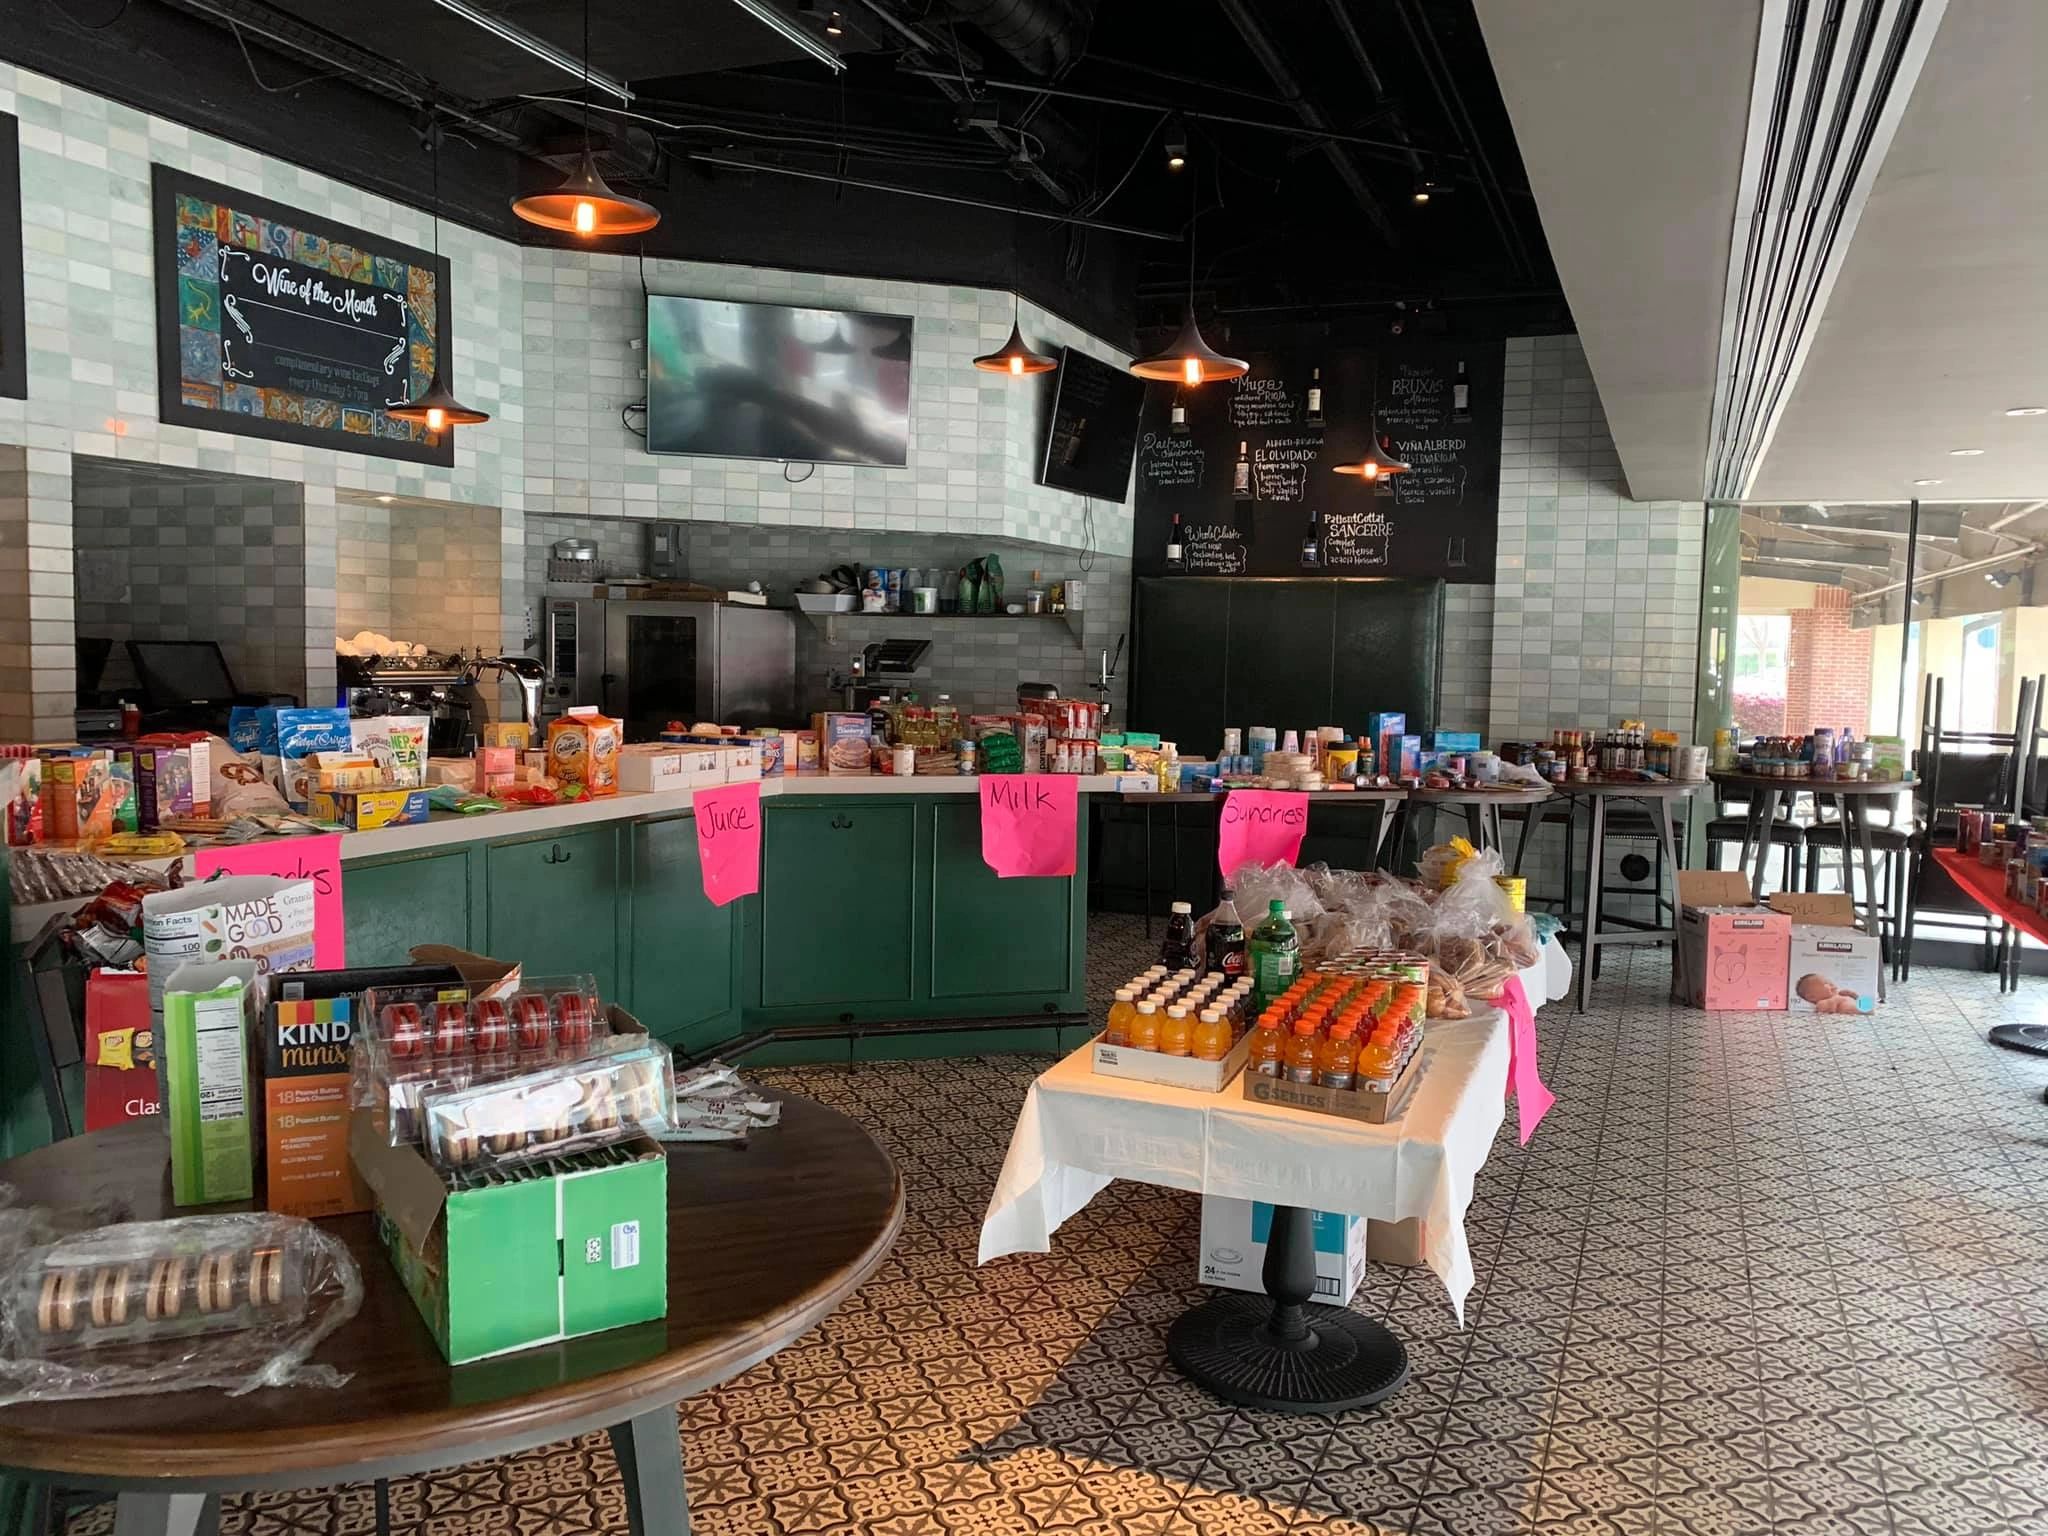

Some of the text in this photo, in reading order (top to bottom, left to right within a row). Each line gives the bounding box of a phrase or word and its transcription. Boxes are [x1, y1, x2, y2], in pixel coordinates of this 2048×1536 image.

[252, 263, 378, 322] Wine of the Month
[1230, 375, 1283, 396] Muga
[1264, 391, 1288, 402] RIOJA
[1423, 439, 1466, 451] ALBERDI
[1255, 448, 1317, 461] EL OLVIDADO
[1329, 521, 1394, 537] SANCERRE
[1344, 546, 1374, 556] intense
[836, 726, 864, 735] Blueberry
[556, 741, 582, 755] Goldfish
[990, 780, 1056, 811] Milk
[1225, 797, 1304, 825] Sundries
[701, 801, 754, 839] Juice
[226, 896, 279, 924] MADE
[165, 916, 193, 926] Facts
[228, 915, 283, 943] GOOD
[183, 942, 201, 952] 100
[1818, 942, 1851, 950] KIRKLAND
[278, 1021, 351, 1047] KIND
[282, 1044, 346, 1068] minis
[200, 1090, 216, 1099] 120
[277, 1091, 295, 1104] 18
[1253, 1082, 1272, 1101] G
[1270, 1087, 1326, 1110] SERIES
[125, 1098, 161, 1117] Clas
[276, 1114, 296, 1129] 18
[1204, 1264, 1216, 1275] 24
